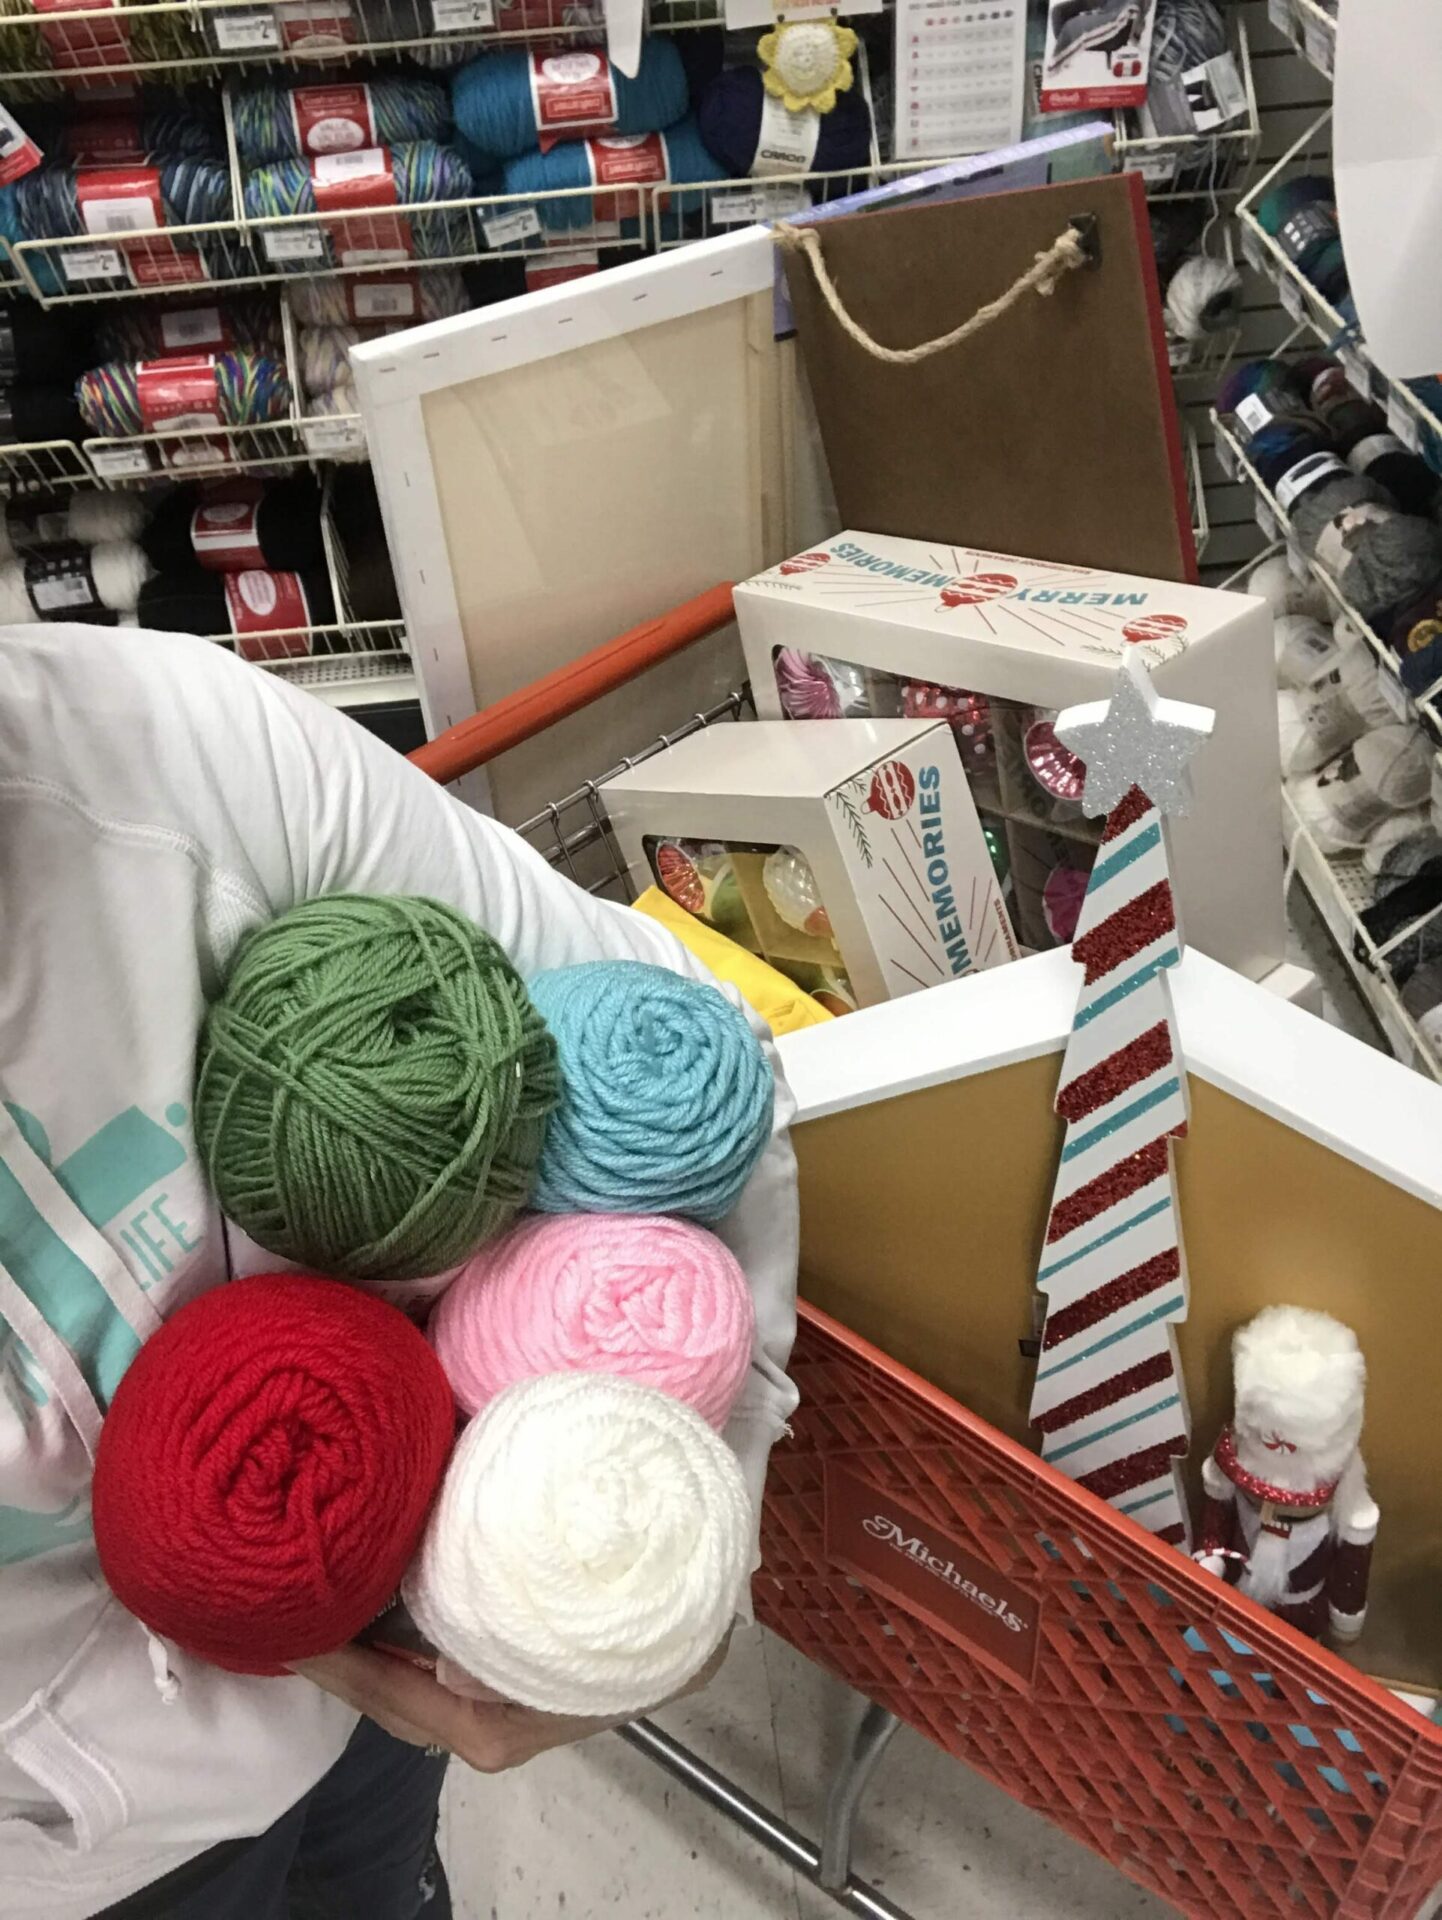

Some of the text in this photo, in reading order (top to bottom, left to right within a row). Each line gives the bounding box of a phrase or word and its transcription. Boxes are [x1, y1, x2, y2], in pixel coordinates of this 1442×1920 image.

[830, 543, 956, 587] MEMORIES
[1006, 588, 1148, 605] MERRY
[918, 764, 972, 975] MEMORIES
[862, 1515, 1022, 1632] Michaels
